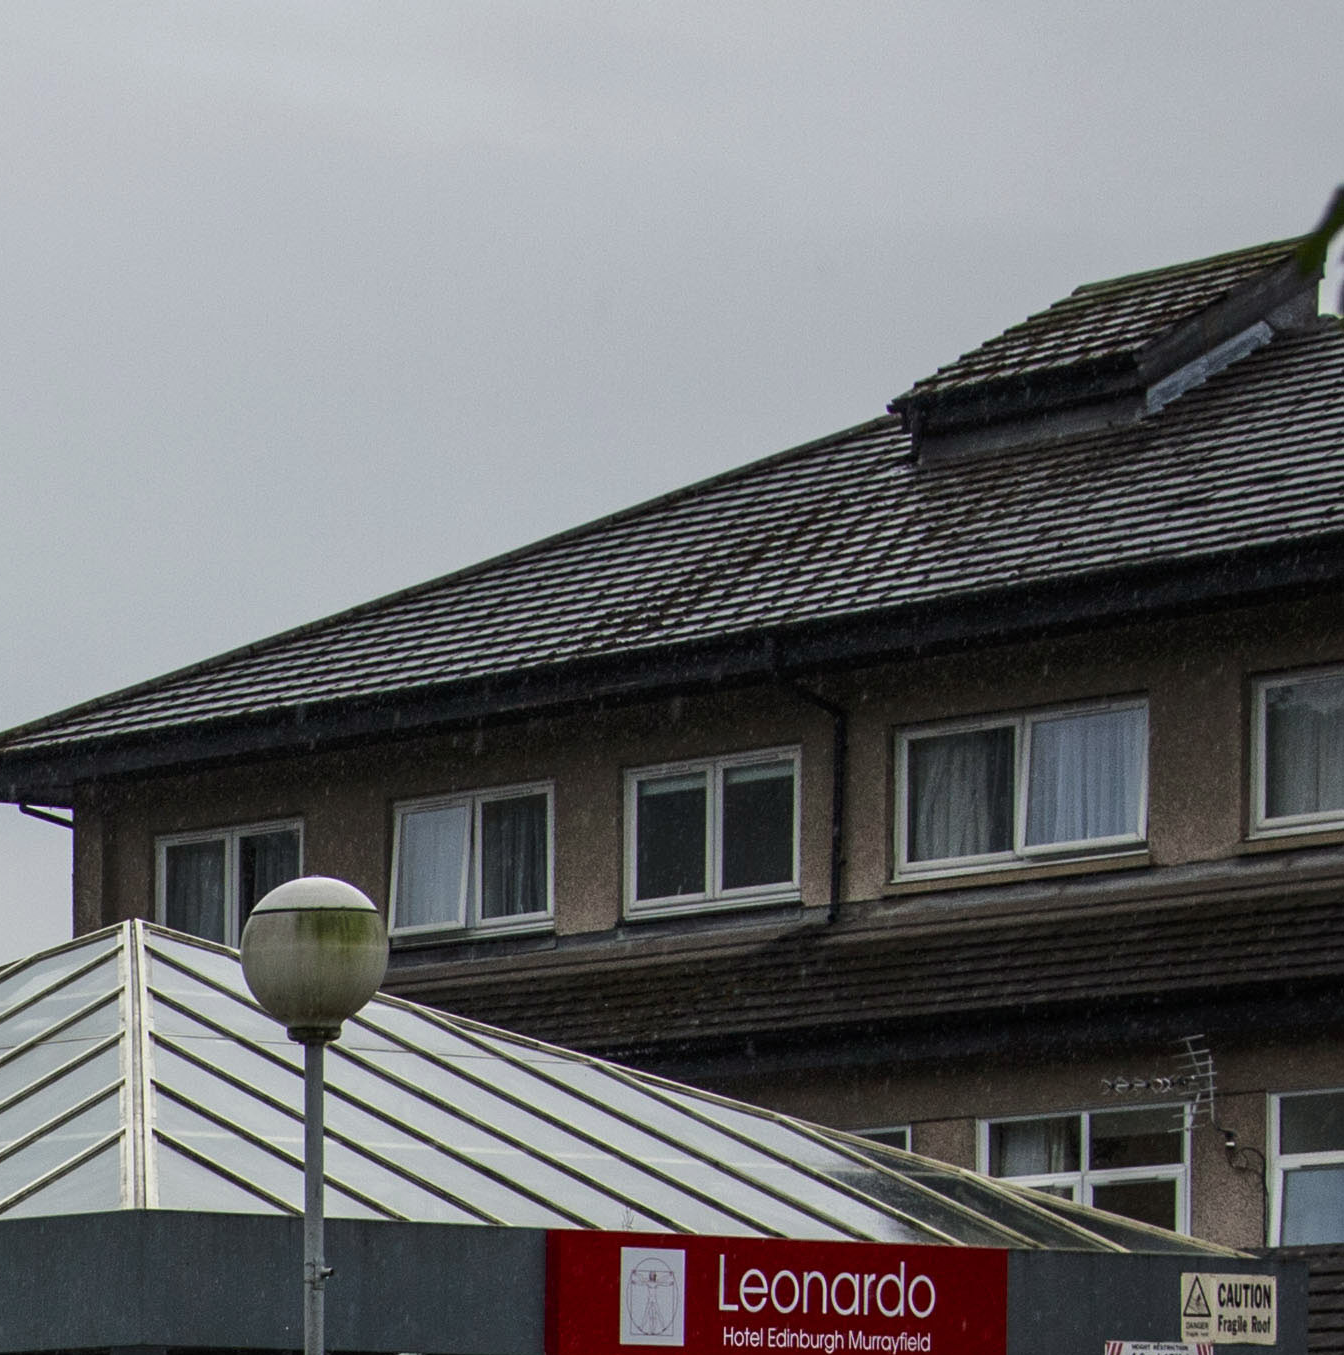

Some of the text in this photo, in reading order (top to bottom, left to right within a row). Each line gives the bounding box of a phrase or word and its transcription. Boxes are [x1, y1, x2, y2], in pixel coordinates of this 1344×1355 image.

[718, 1253, 936, 1319] Leonardo
[1217, 1283, 1272, 1309] CAUTION
[1217, 1314, 1271, 1336] Fragile Roof
[723, 1326, 931, 1355] Hotel Edinburgh Murrayfield
